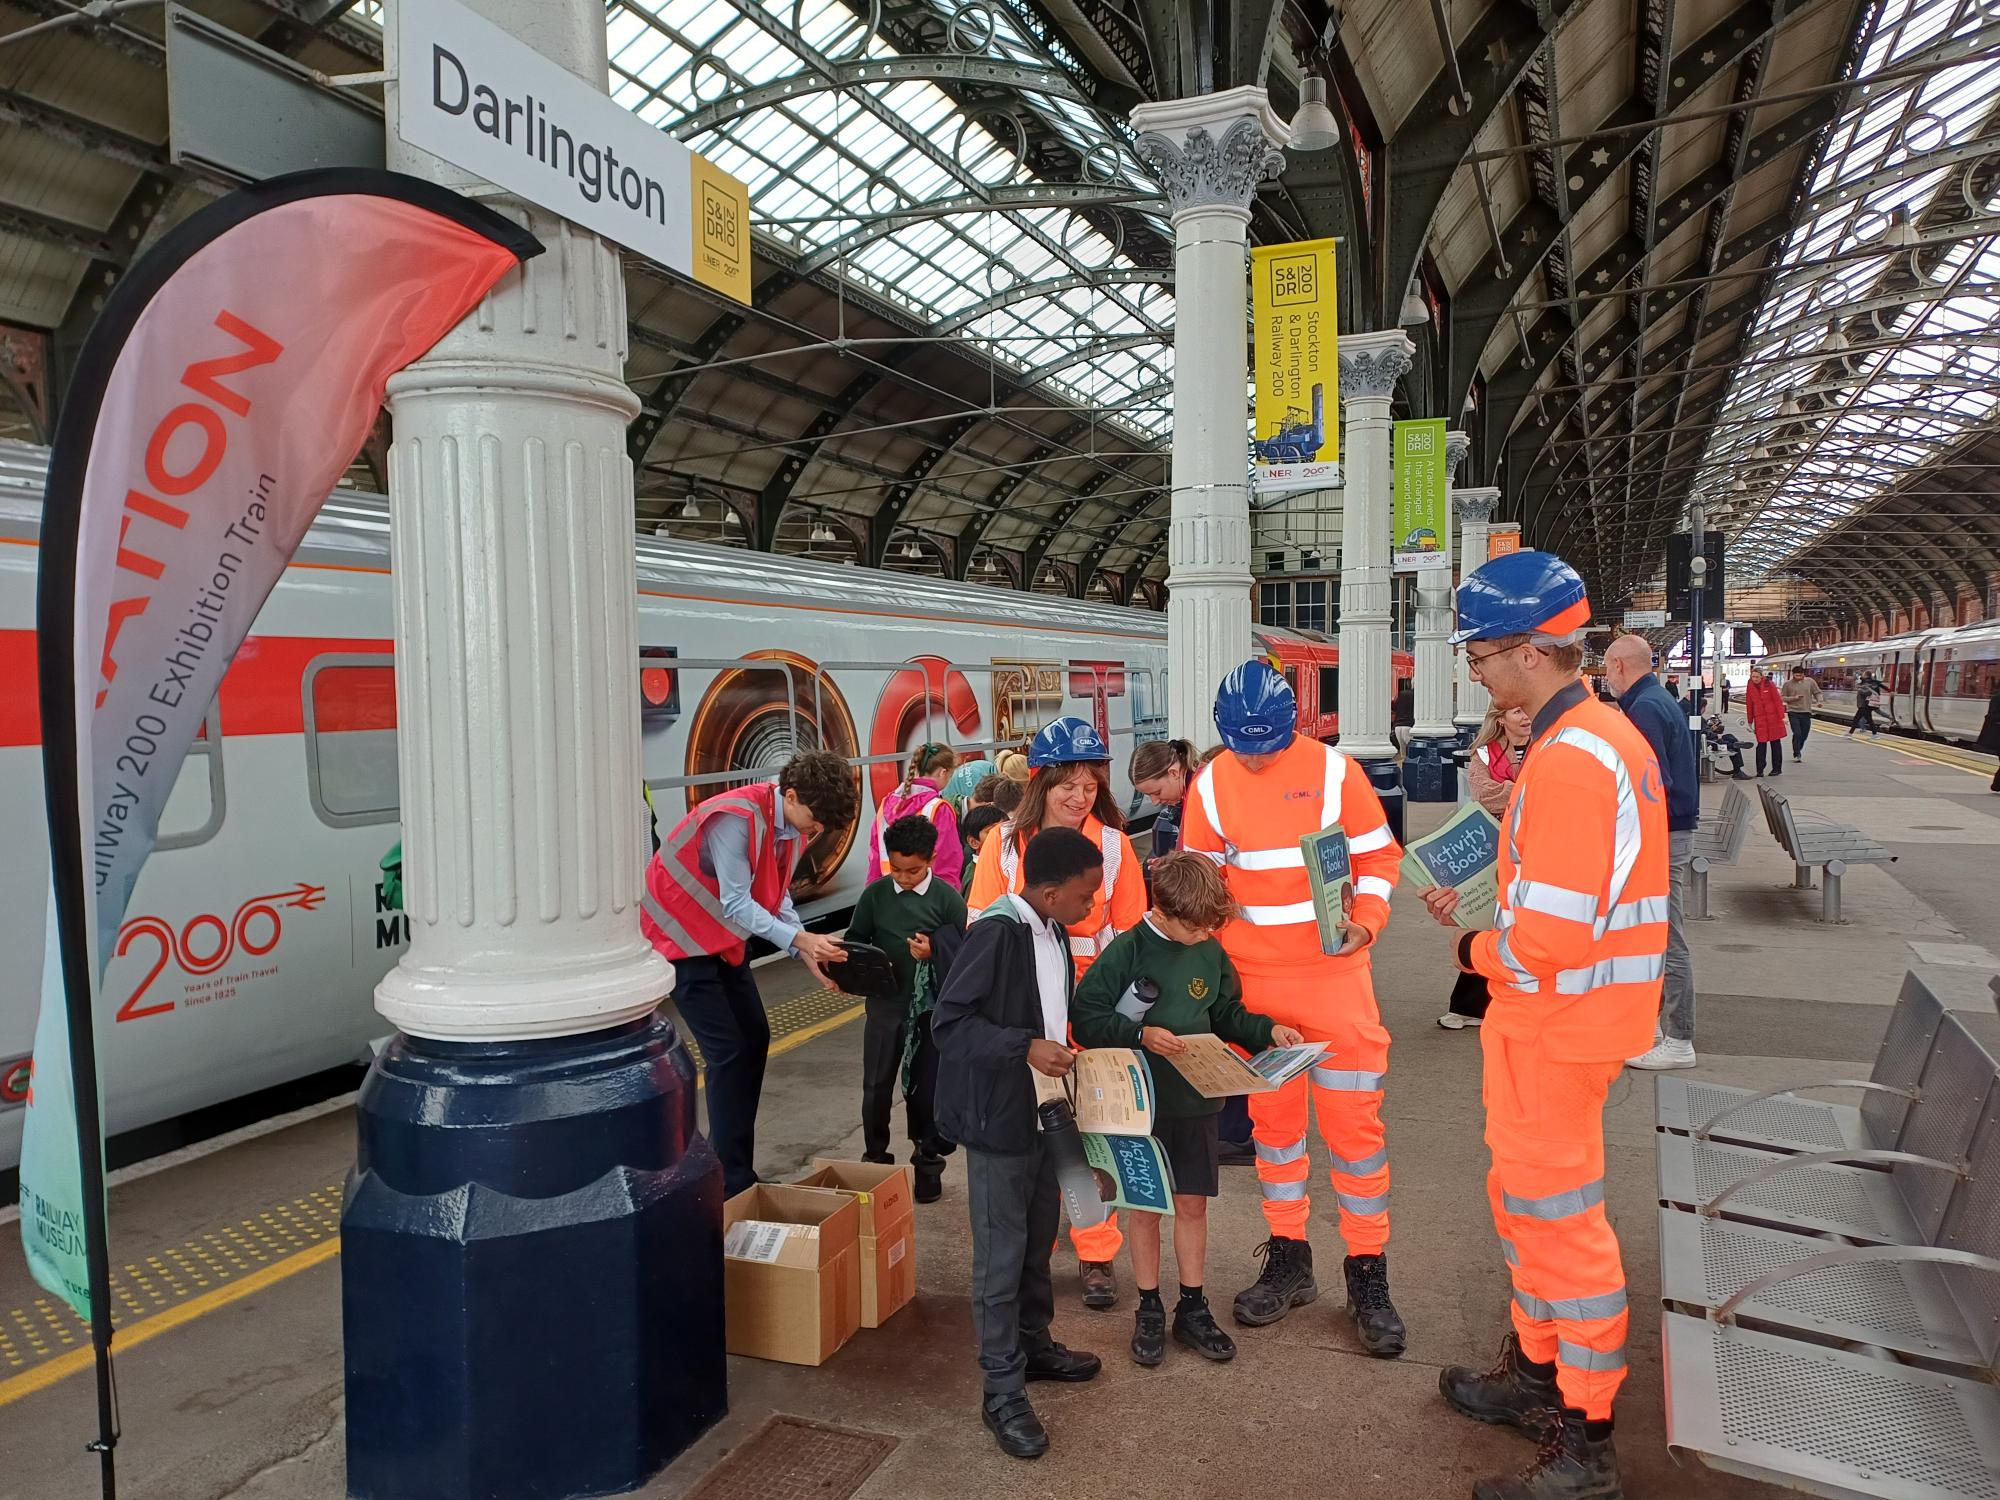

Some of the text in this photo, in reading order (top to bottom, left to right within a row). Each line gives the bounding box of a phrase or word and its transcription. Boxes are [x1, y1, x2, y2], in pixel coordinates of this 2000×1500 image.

[433, 43, 665, 225] Darlington
[706, 197, 723, 221] S&
[706, 216, 724, 242] DR
[726, 207, 735, 247] 200
[1275, 267, 1296, 282] S&
[1301, 265, 1313, 293] 200
[1276, 282, 1297, 296] DR
[1308, 311, 1320, 372] Stockton
[1270, 315, 1285, 397] Railway 200
[1288, 314, 1302, 399] & Darlington
[1408, 442, 1421, 451] DR
[1423, 432, 1432, 450] 200
[1262, 469, 1292, 478] LNER
[1303, 467, 1325, 478] 200
[1427, 468, 1435, 487] train
[1404, 478, 1412, 499] world
[1414, 480, 1423, 515] changed
[1404, 502, 1412, 529] forever
[1427, 499, 1435, 526] events
[95, 473, 277, 897] ailway 200 Exhibition Train
[1292, 791, 1311, 799] CML
[1428, 825, 1487, 868] Activity
[1447, 845, 1488, 875] Book
[1326, 860, 1342, 874] Book
[116, 905, 281, 1022] 200
[184, 966, 278, 993] Years of Train Travel
[184, 994, 211, 1007] Since
[1120, 1149, 1138, 1184] Book
[1128, 1140, 1156, 1200] Activity
